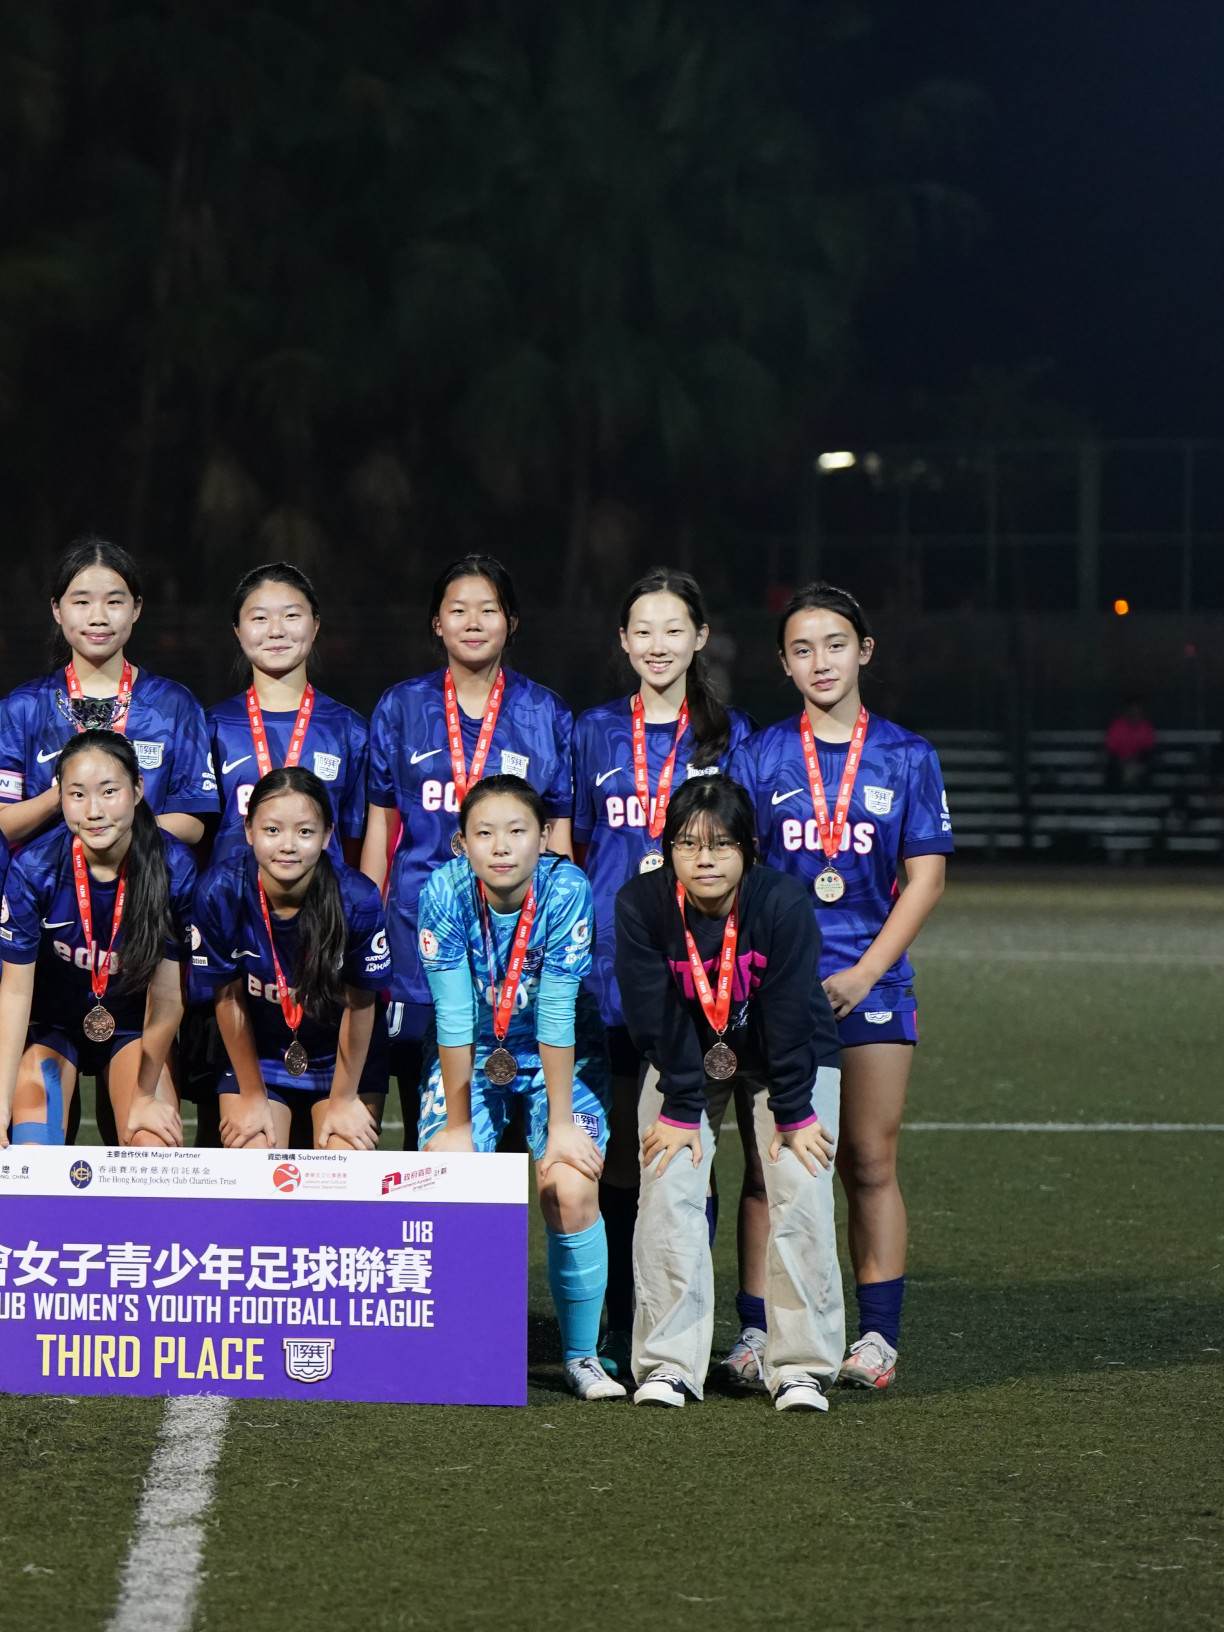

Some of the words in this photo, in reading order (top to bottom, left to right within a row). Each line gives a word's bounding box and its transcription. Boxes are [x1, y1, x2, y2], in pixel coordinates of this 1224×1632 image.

[151, 1151, 172, 1159] Major
[338, 1154, 347, 1163] by
[112, 1176, 130, 1185] Hong
[131, 1176, 148, 1185] Kong
[149, 1176, 171, 1185] Jockey
[189, 1177, 218, 1185] Charities
[402, 1220, 433, 1243] U18
[146, 1294, 221, 1323] YOUTH
[229, 1296, 342, 1326] FOOTBALL
[349, 1298, 434, 1328] LEAGUE
[36, 1334, 141, 1377] THIRD
[154, 1336, 265, 1381] PLACE
